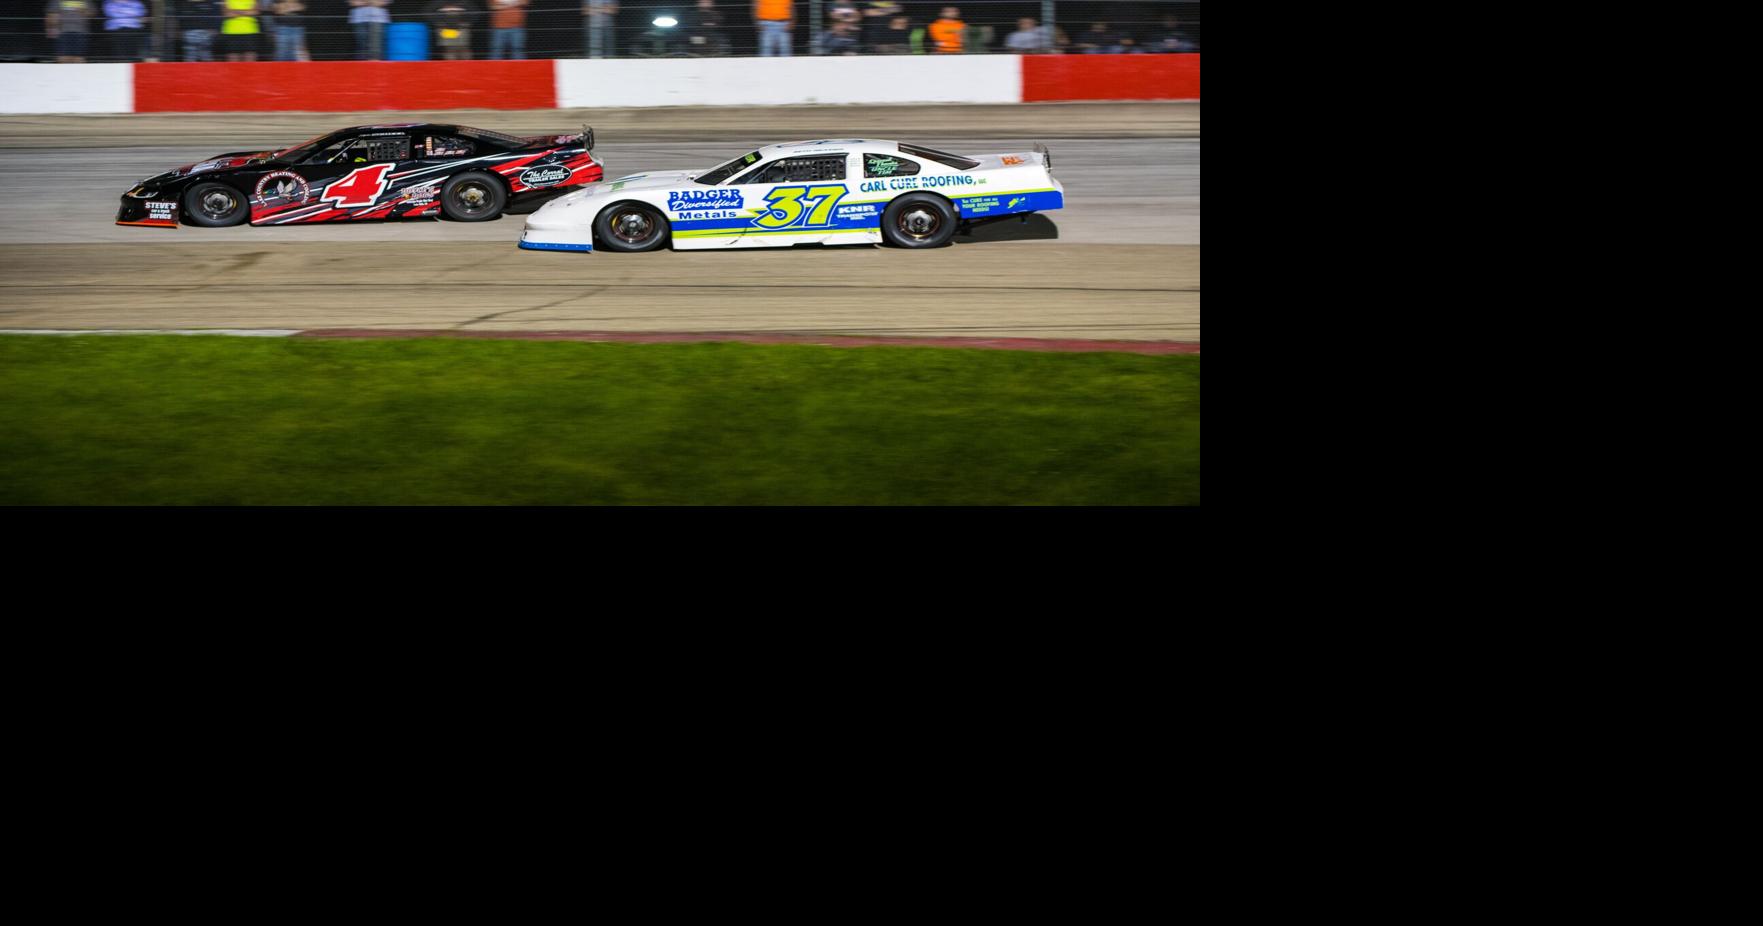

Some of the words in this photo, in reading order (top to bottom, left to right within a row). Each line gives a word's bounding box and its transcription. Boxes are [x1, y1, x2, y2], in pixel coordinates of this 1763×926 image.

[320, 162, 396, 208] 4
[860, 180, 887, 192] CARL
[890, 177, 919, 190] CURE
[922, 175, 977, 188] ROOFING,
[669, 189, 742, 201] BADGER
[672, 199, 741, 211] Diversified
[750, 183, 850, 230] 37
[837, 204, 876, 215] KNR
[679, 210, 737, 219] Metals
